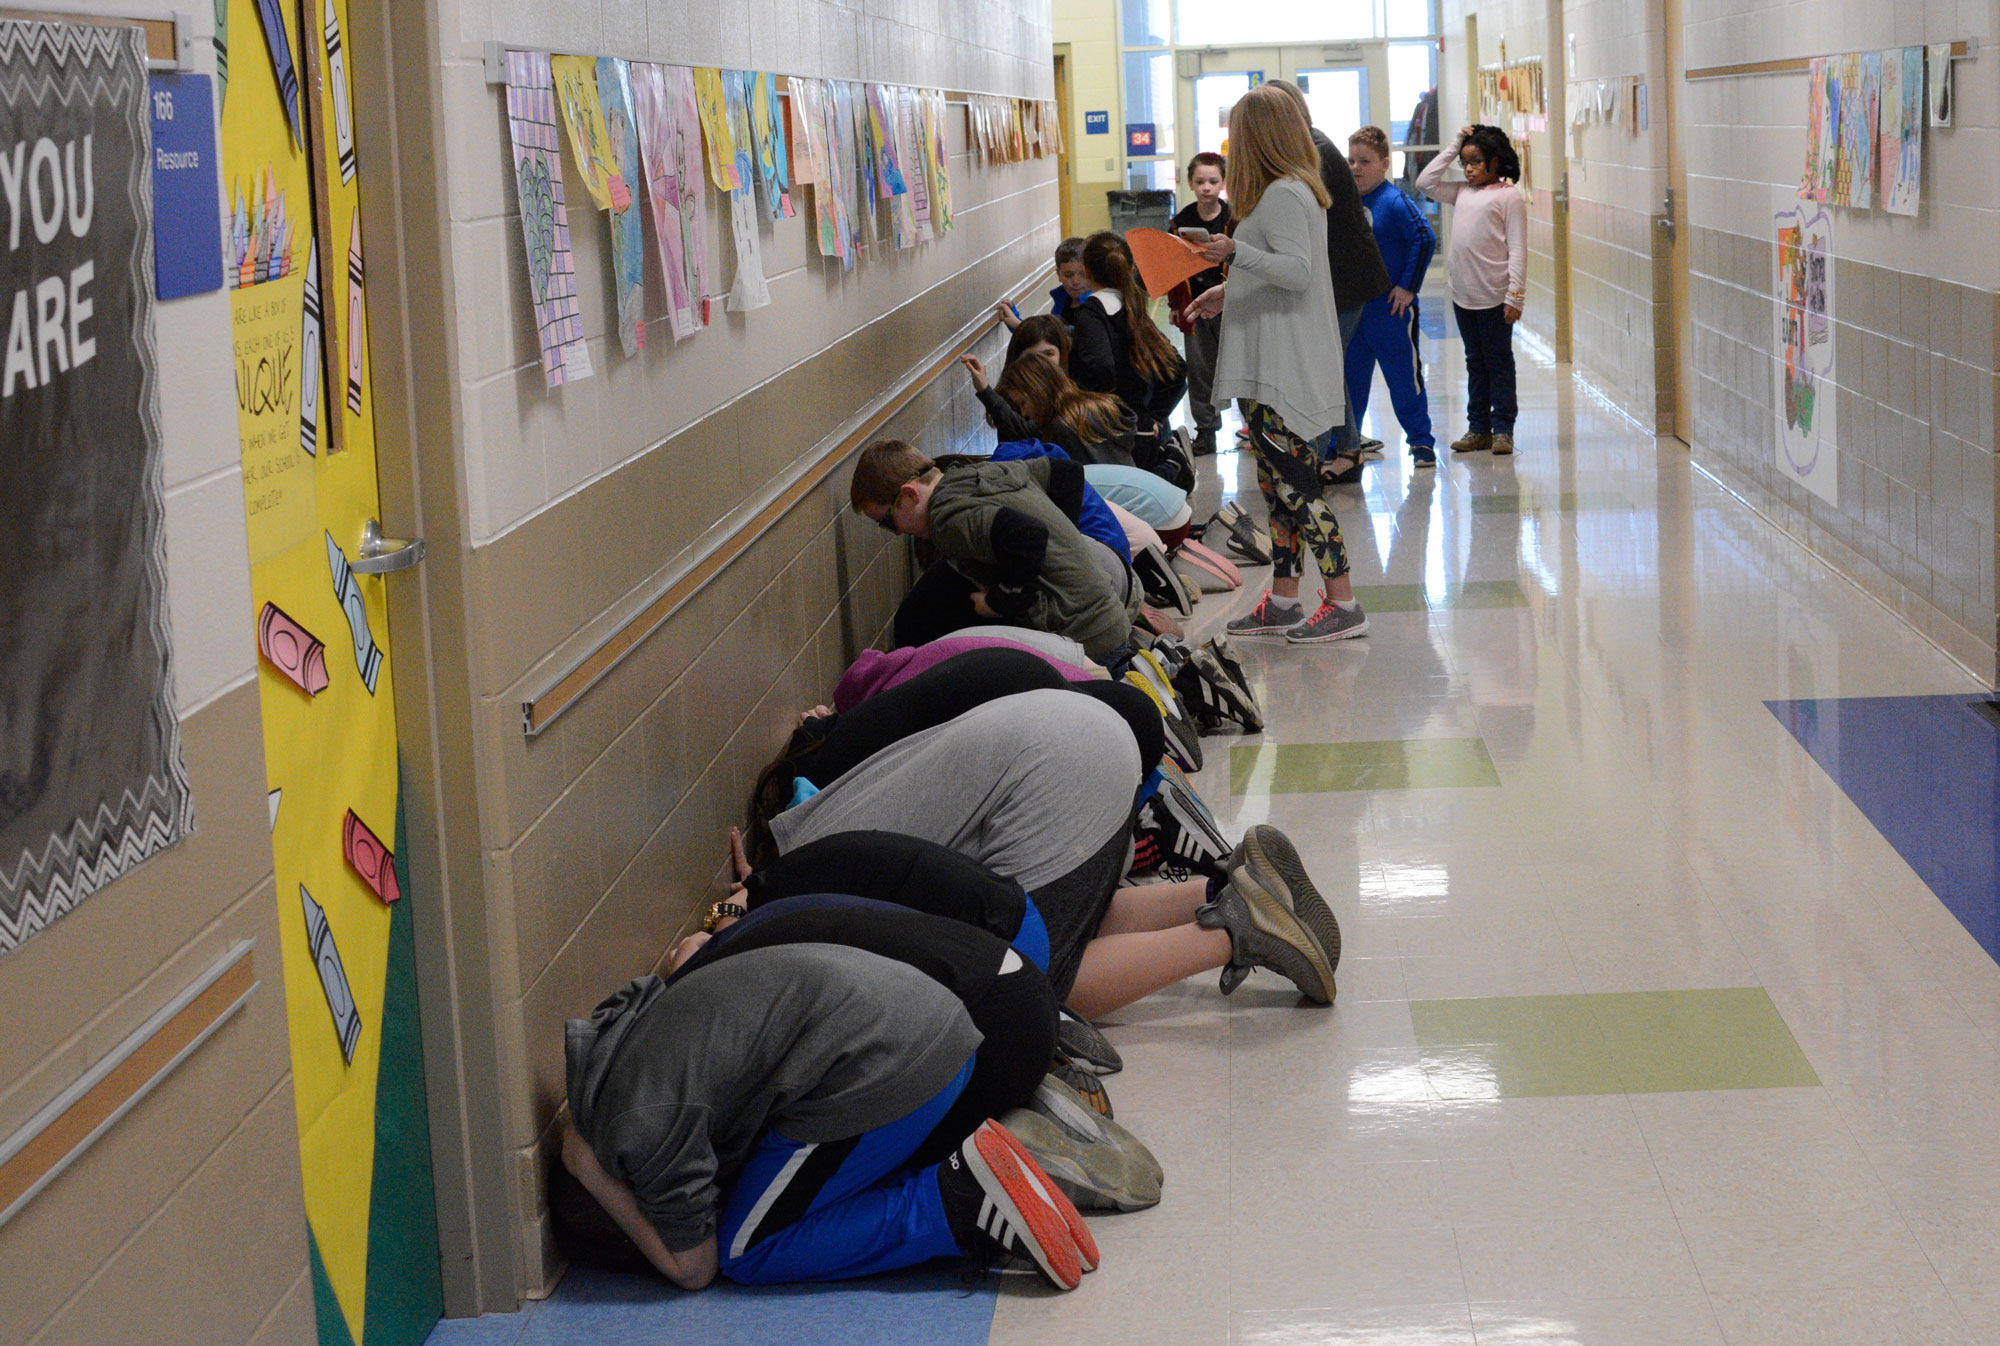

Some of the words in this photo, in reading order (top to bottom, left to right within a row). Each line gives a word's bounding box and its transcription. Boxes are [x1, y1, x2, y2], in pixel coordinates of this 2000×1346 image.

[153, 91, 174, 120] 166
[1087, 114, 1106, 123] EXIT
[1134, 133, 1151, 145] 34
[156, 148, 199, 170] Resource
[0, 133, 95, 251] YOU
[2, 259, 97, 398] ARE
[235, 344, 292, 416] NIQUE
